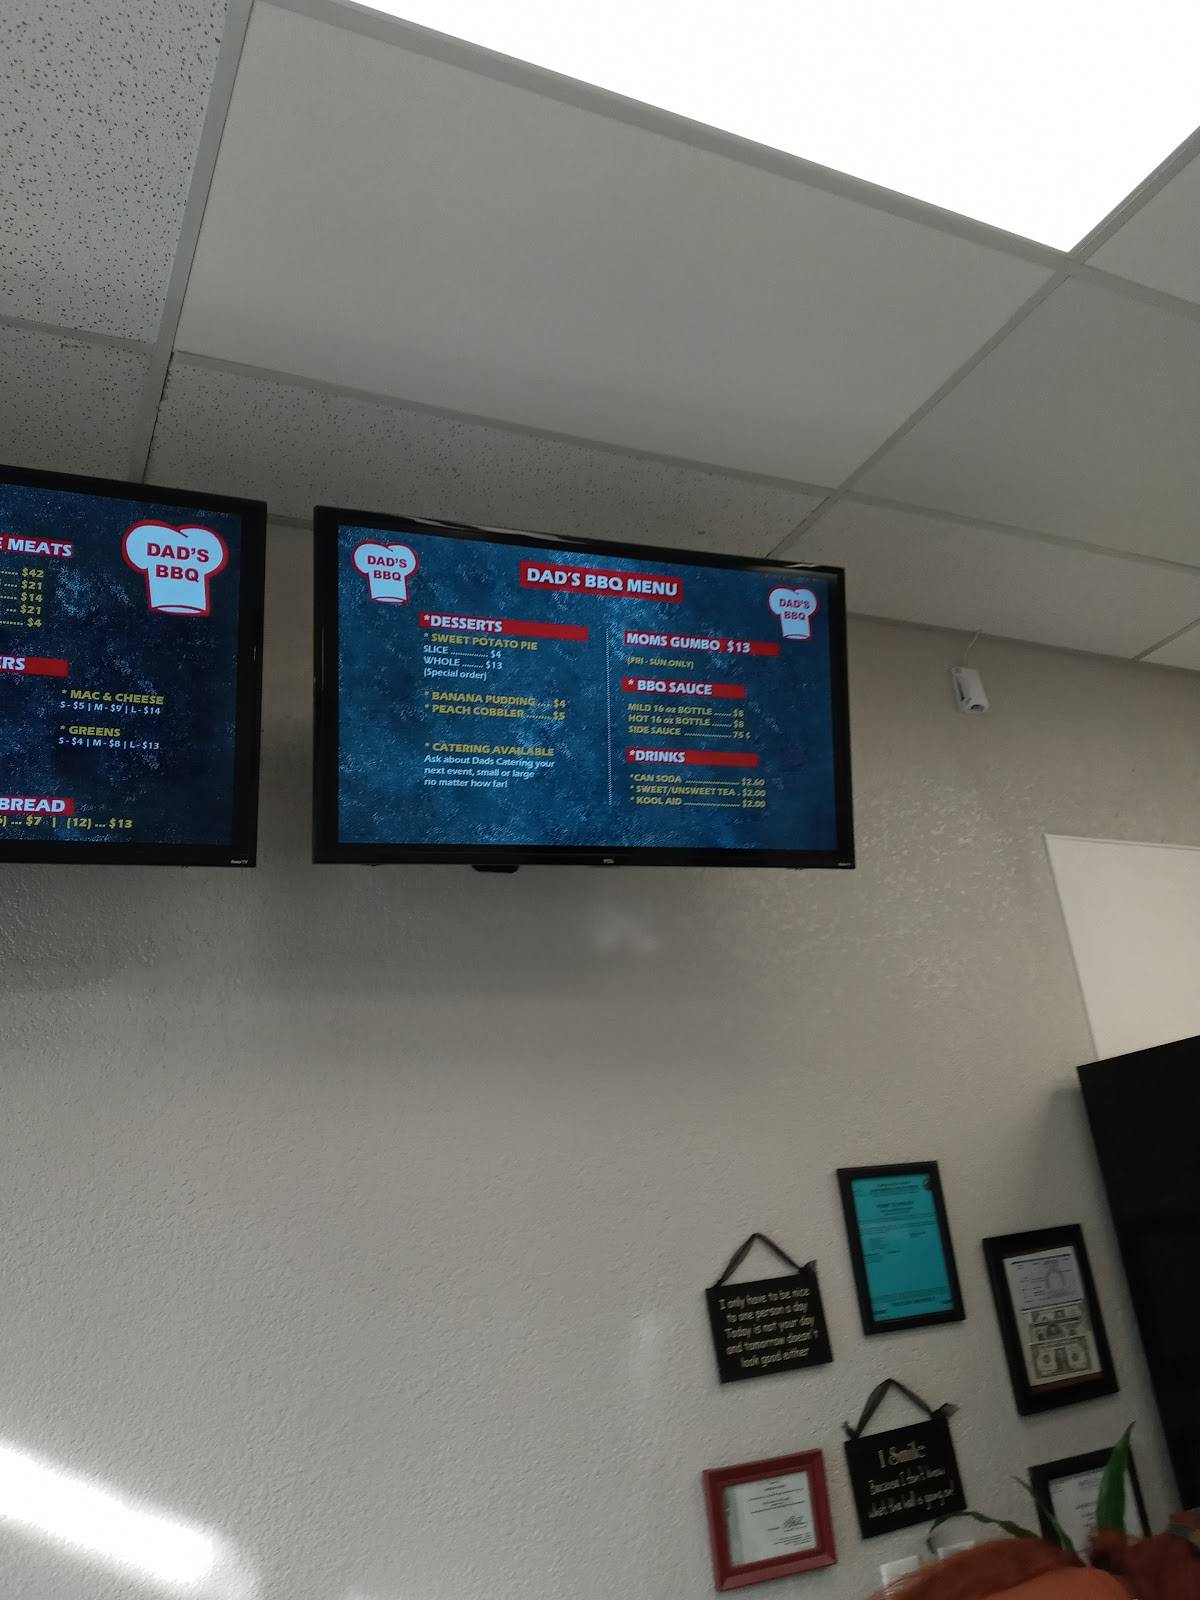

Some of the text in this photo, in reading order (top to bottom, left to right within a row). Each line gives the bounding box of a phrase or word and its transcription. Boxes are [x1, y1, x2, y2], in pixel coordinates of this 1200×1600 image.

[7, 538, 72, 557] MEATS
[146, 542, 210, 563] DAD'S
[367, 555, 408, 568] DAD'S
[21, 567, 44, 578] $42
[155, 564, 199, 583] BBQ
[373, 570, 402, 582] BBQ
[21, 579, 42, 590] $21
[527, 567, 678, 597] DAD'S BBQ MENU
[20, 591, 44, 602] $14
[20, 604, 42, 615] $21
[779, 598, 810, 610] DAD'S
[26, 617, 42, 627] $4
[784, 611, 806, 620] BBQ
[430, 633, 539, 650] SWEET POTATO PIE
[626, 633, 751, 653] MOMS GUMBO $13
[423, 644, 502, 659] SLICE $4
[0, 656, 26, 670] RS
[423, 656, 503, 670] WHOLE $13
[423, 668, 488, 682] (Special order)
[637, 680, 712, 695] BBQ SAUCE
[70, 689, 165, 705] MAC & CHEESE
[431, 691, 567, 709] BANANA PUDDING $4
[431, 704, 566, 721] PEACH COBBLER $5
[627, 703, 652, 712] MILD
[653, 704, 664, 713] 16
[678, 706, 713, 716] BOTTLE
[628, 714, 649, 722] HOT
[651, 716, 664, 724] 16
[674, 717, 711, 726] BOTTLE
[68, 725, 121, 737] GREENS
[628, 726, 650, 734] SIDE
[651, 726, 682, 736] SAUCE
[432, 742, 555, 757] CATERING AVAILABLE
[424, 754, 555, 770] Ask about Dads Catering your
[446, 768, 475, 776] event,
[476, 768, 500, 776] small
[512, 769, 535, 780] large
[656, 774, 682, 783] SODA
[438, 778, 470, 787] matter
[470, 779, 491, 788] how
[718, 788, 736, 796] TEA
[0, 797, 66, 813] BREAD
[636, 796, 664, 804] KOOL
[665, 797, 682, 805] AID
[25, 814, 42, 827] $7
[66, 818, 92, 829] (12)
[108, 817, 133, 829] $13
